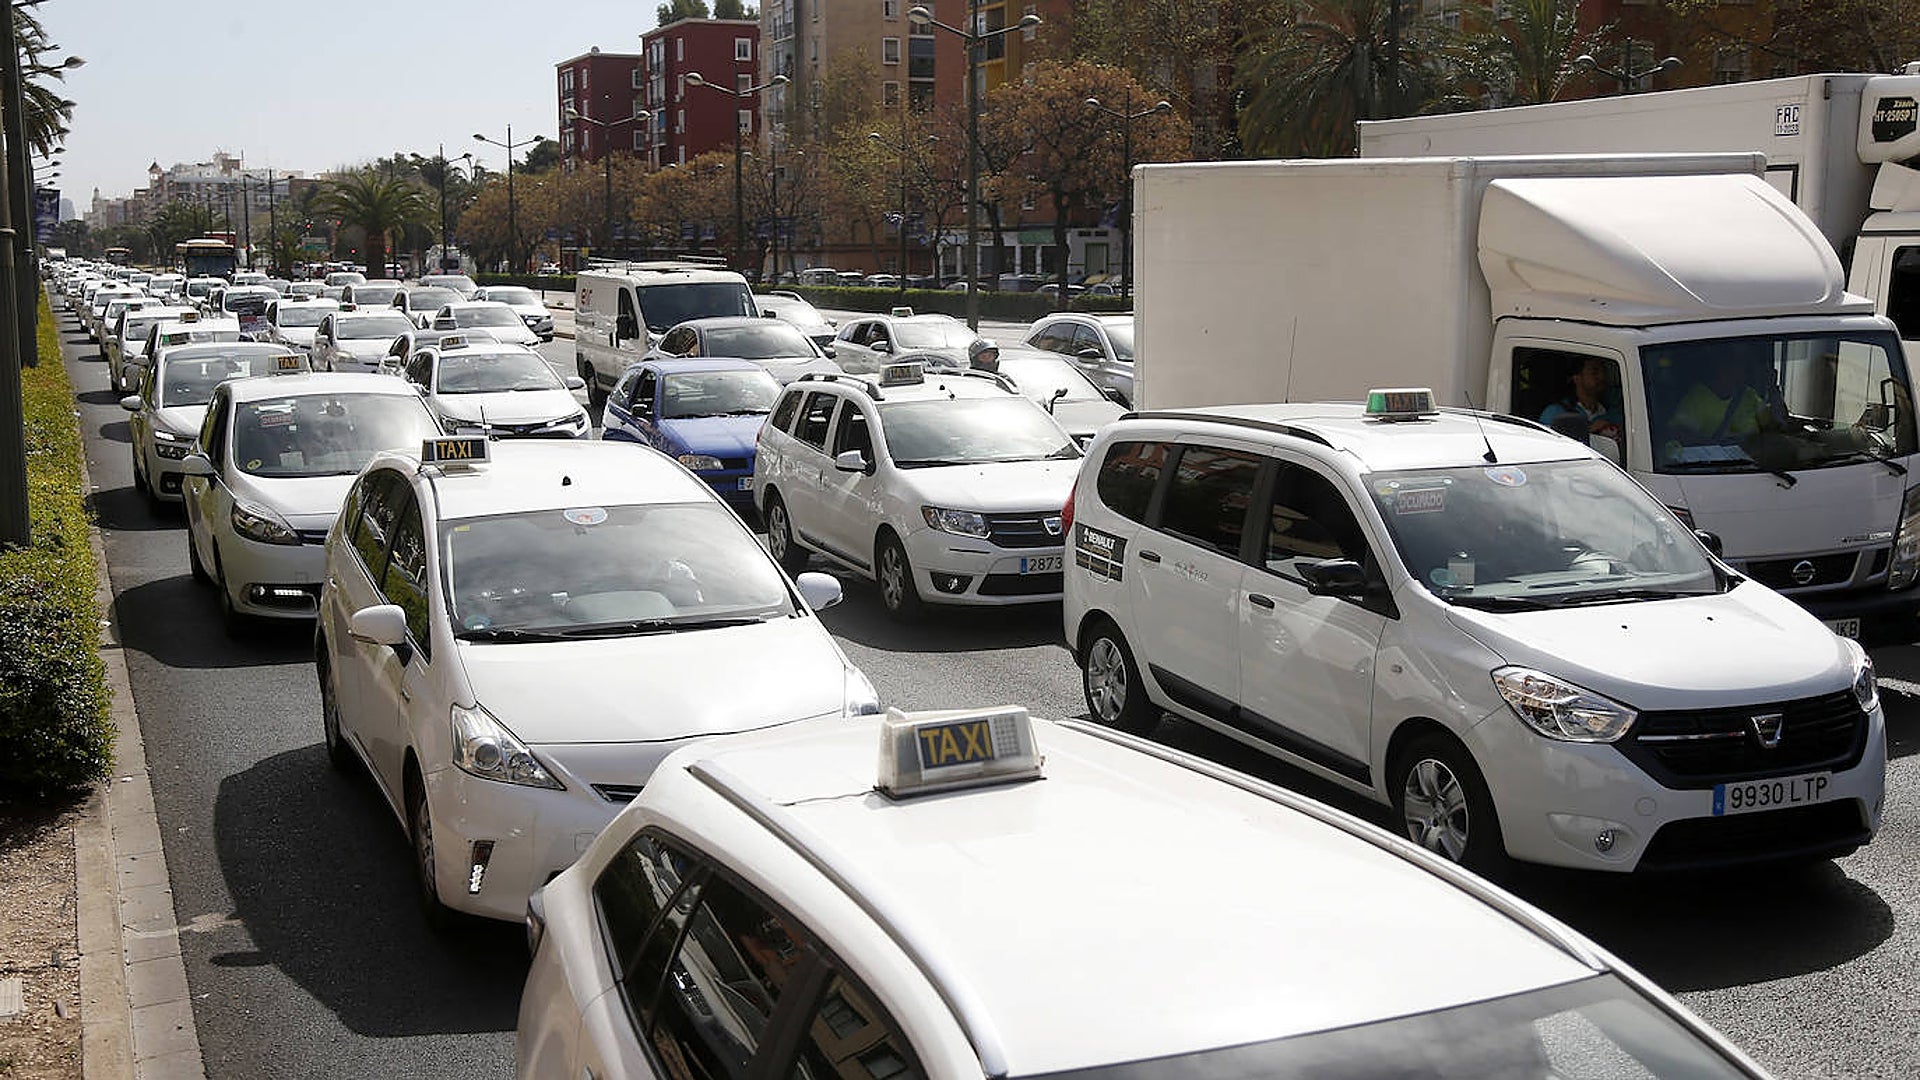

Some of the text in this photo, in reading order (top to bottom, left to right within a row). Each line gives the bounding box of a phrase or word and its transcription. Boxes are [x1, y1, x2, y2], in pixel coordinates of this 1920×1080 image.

[278, 357, 299, 369] TAXI
[437, 441, 472, 458] TAXI
[1089, 531, 1116, 550] RENAULT
[1029, 557, 1063, 572] 2873
[919, 722, 993, 765] TAXI
[1731, 776, 1828, 809] 9930 LTP
